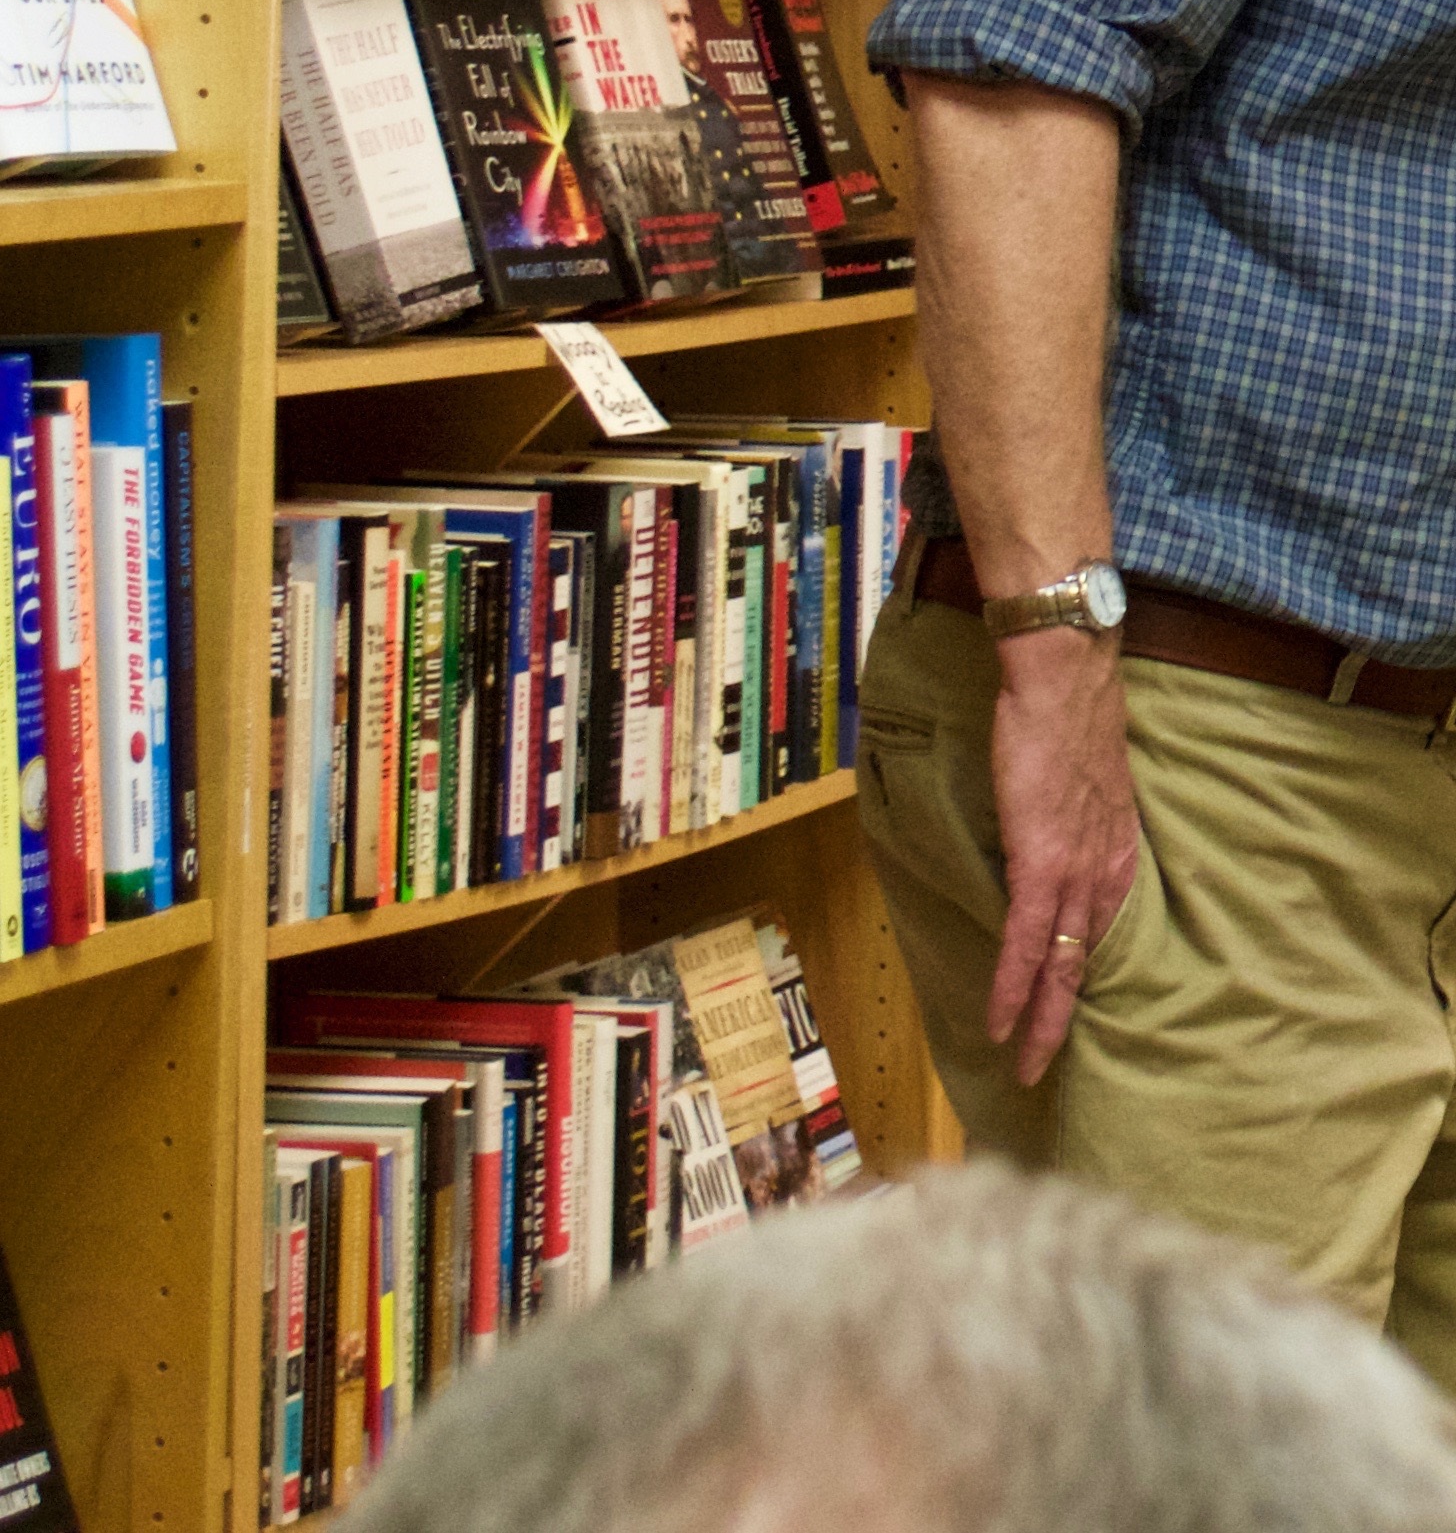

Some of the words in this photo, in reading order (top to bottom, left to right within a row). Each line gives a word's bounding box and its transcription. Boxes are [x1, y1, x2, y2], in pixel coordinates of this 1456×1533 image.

[462, 14, 547, 63] Electrifying
[577, 4, 600, 37] IN
[586, 39, 626, 72] THE
[706, 38, 759, 64] CUSTER'S
[12, 63, 53, 85] TIM
[61, 62, 146, 85] HARFORD
[499, 71, 516, 105] of
[724, 71, 768, 97] TRIALS
[597, 74, 662, 111] WATER
[464, 110, 528, 146] Rainbow
[125, 466, 141, 515] THE
[12, 431, 42, 647] EURO
[126, 522, 143, 644] FORBIDDEN
[128, 653, 145, 718] GAME
